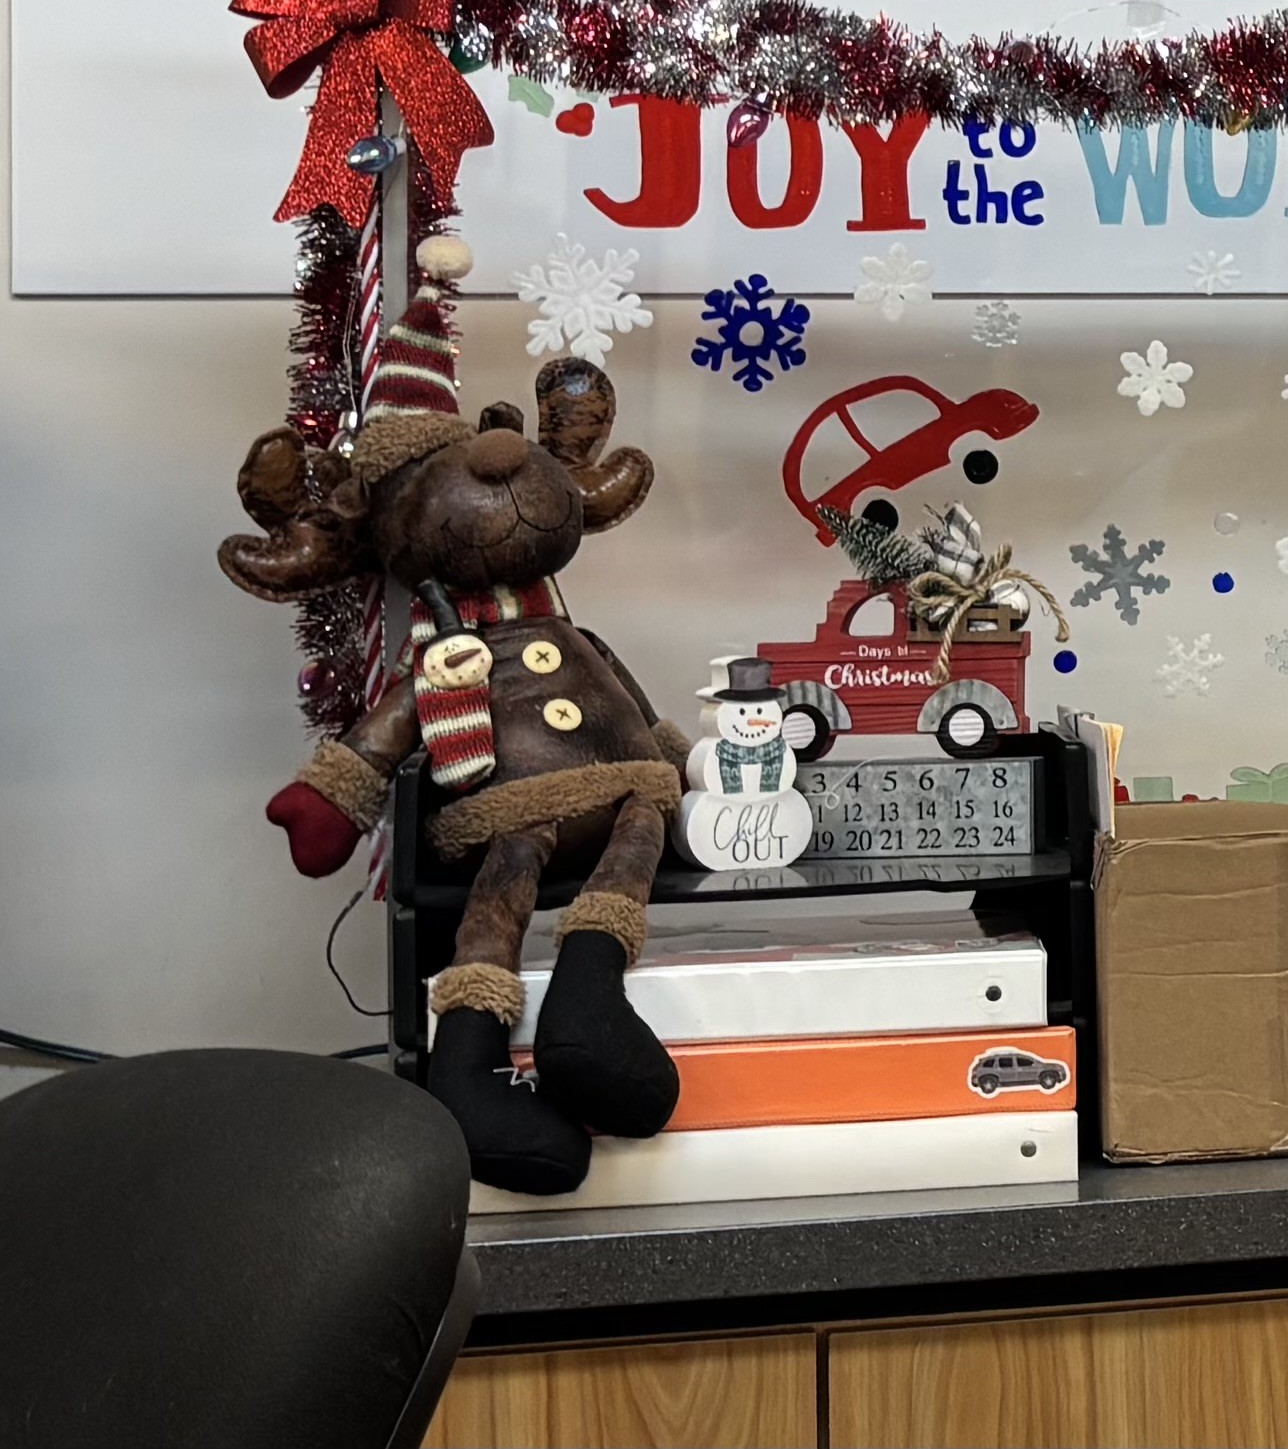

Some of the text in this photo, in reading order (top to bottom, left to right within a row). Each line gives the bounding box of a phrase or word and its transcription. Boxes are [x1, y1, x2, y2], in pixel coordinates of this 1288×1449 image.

[962, 112, 1037, 159] to
[583, 94, 941, 231] JOY
[942, 160, 1044, 226] the
[858, 644, 891, 659] Days
[824, 663, 936, 690] Christmas
[811, 766, 1008, 794] 3 4 5 6 7 8
[843, 802, 863, 823] 12
[880, 801, 900, 823] 13
[915, 800, 937, 820] 14
[954, 799, 975, 820] 15
[992, 799, 1014, 819] 16
[714, 801, 784, 850] Chill
[814, 825, 1016, 853] 19 20 21 22 23 24
[732, 835, 790, 864] OUT
